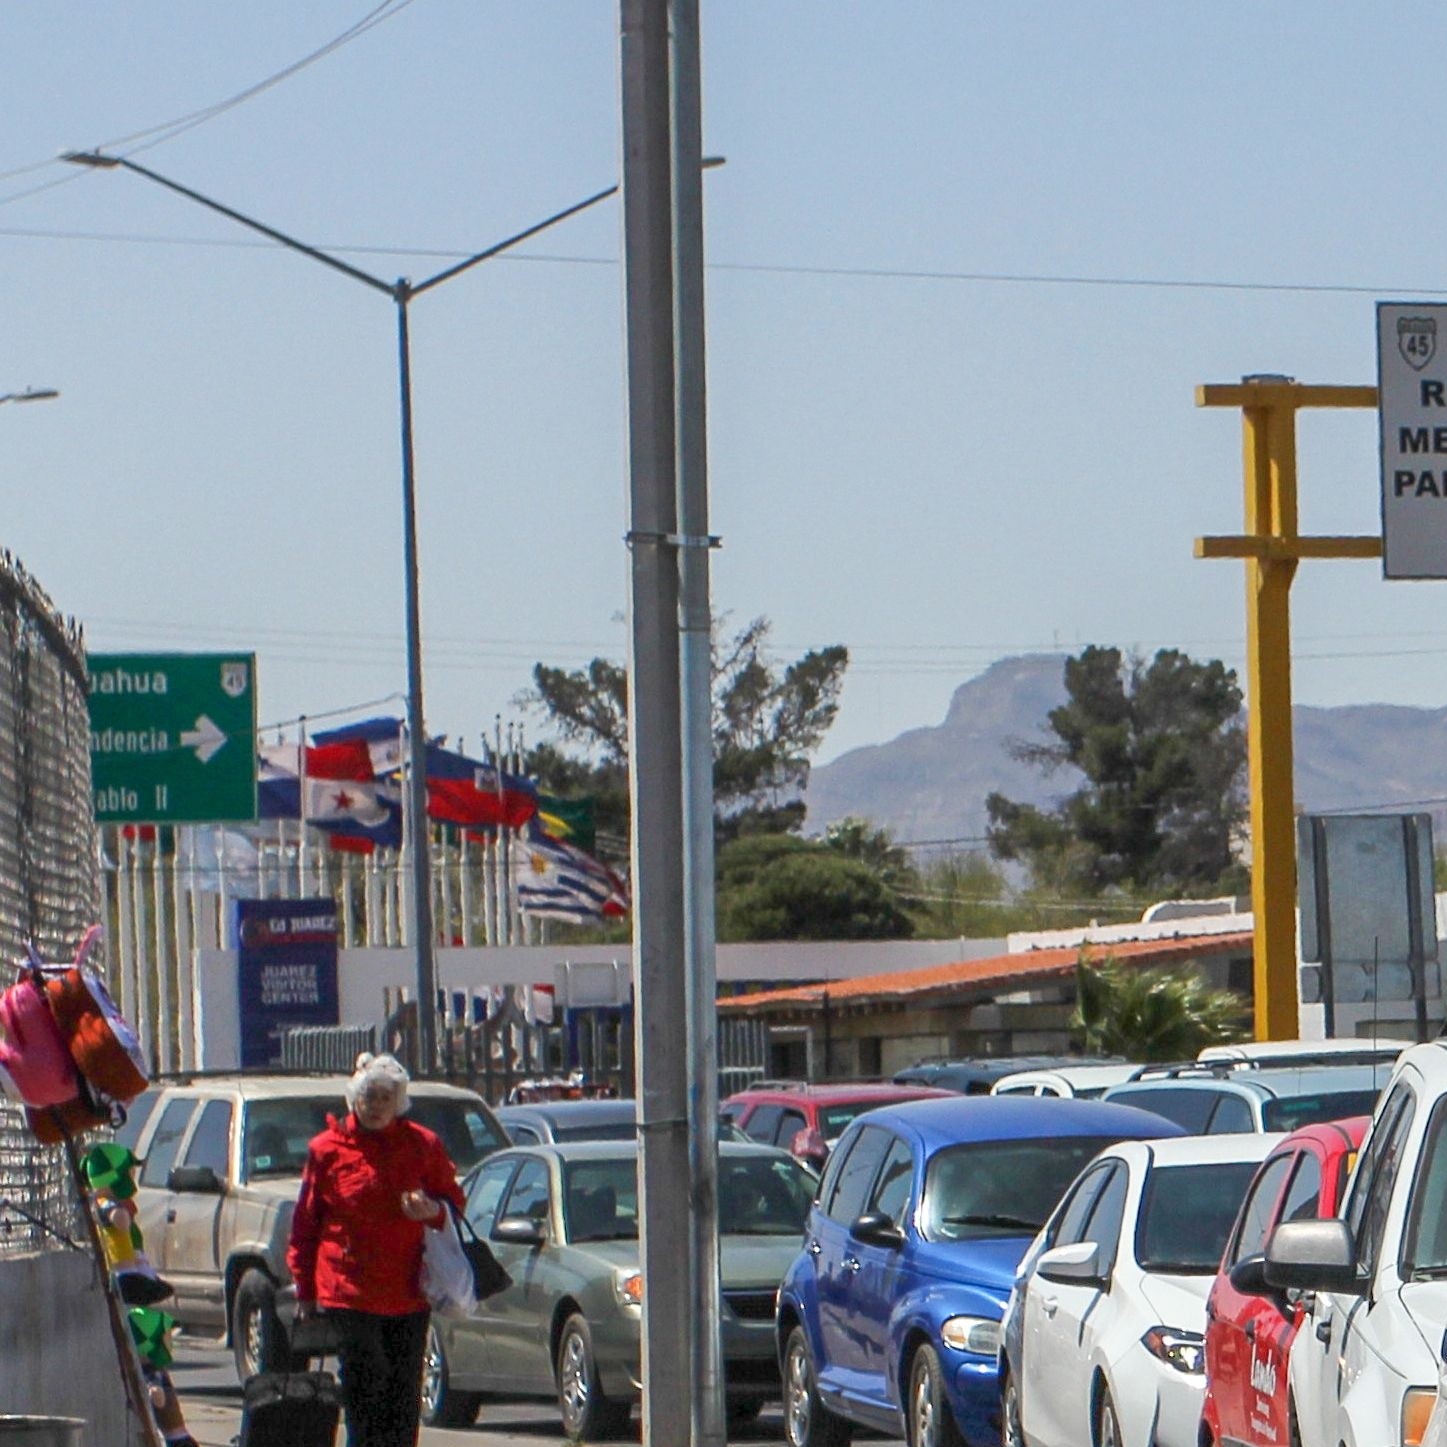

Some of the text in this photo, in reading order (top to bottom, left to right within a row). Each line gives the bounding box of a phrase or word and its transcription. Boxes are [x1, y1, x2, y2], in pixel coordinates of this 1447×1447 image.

[1406, 335, 1429, 356] 45
[290, 915, 336, 932] JUAREZ
[264, 965, 317, 976] JUAREZ
[262, 979, 318, 990] VISITOR
[262, 992, 319, 1004] CENTER
